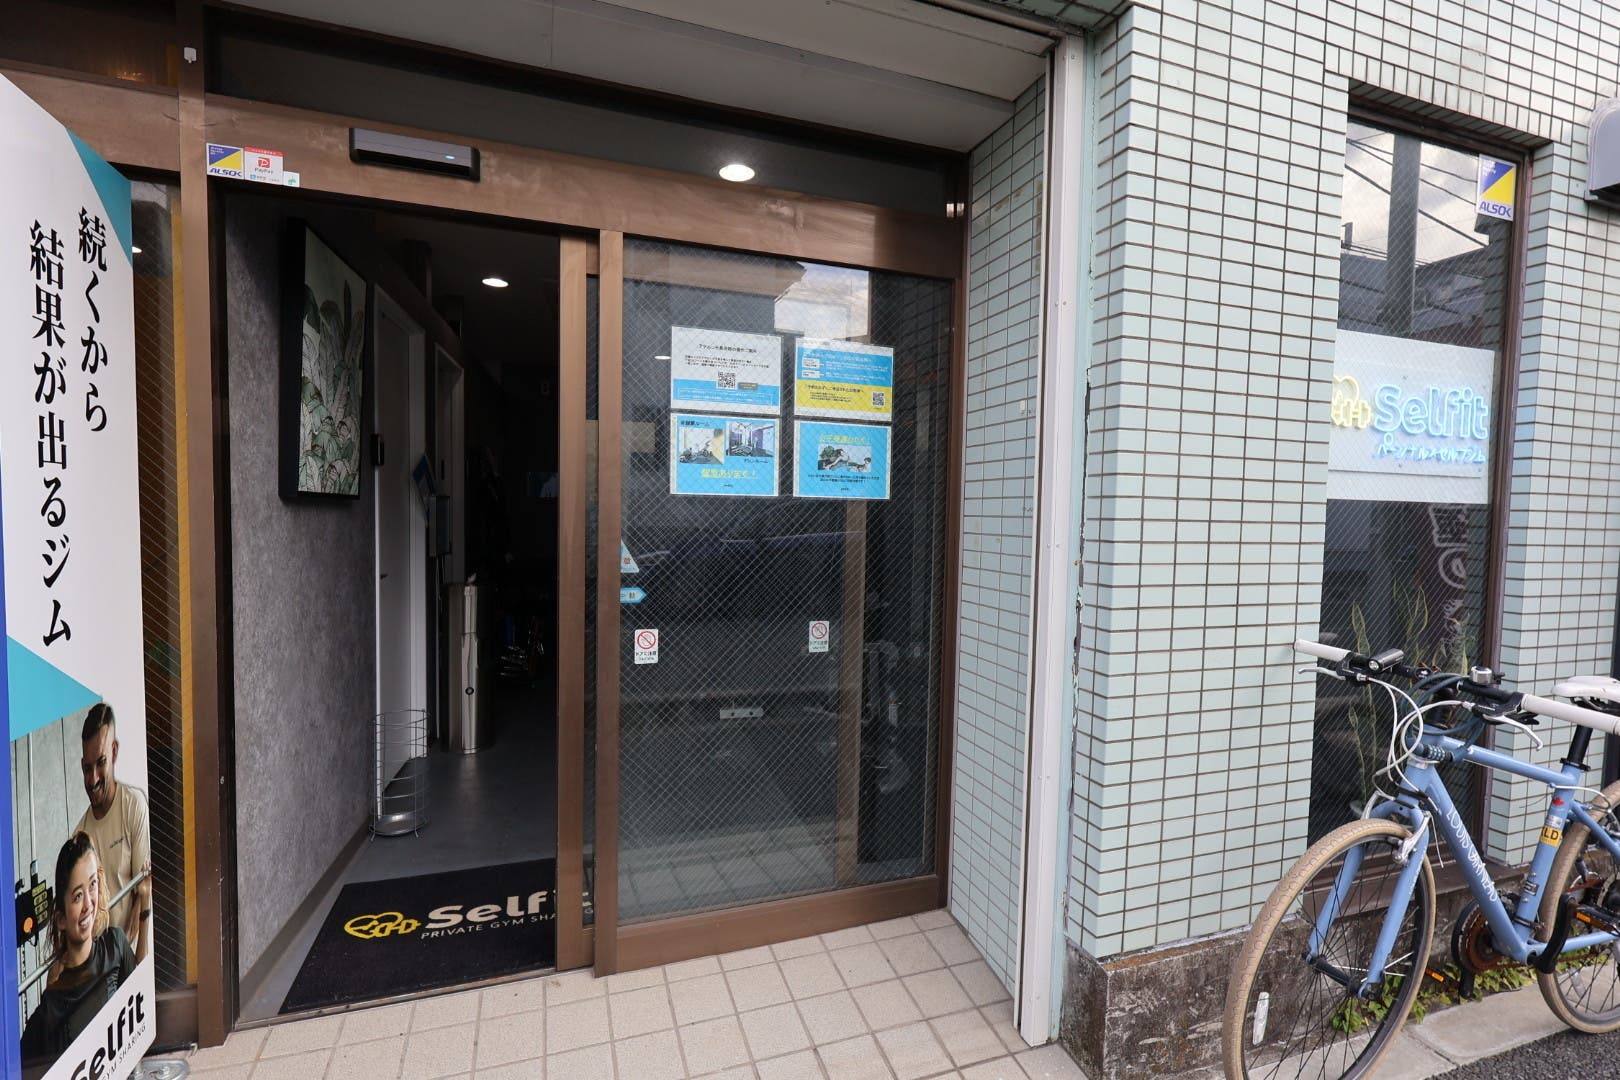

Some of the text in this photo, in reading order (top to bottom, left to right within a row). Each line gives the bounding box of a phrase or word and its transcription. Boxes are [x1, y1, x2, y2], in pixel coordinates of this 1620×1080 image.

[210, 167, 242, 177] ALSOK
[1479, 201, 1511, 217] ALSOK
[78, 206, 108, 432] 続くから
[1373, 384, 1488, 439] Selfit
[29, 218, 71, 647] 結果が出るジム
[421, 925, 484, 940] PRIVATE
[490, 918, 525, 929] GYM
